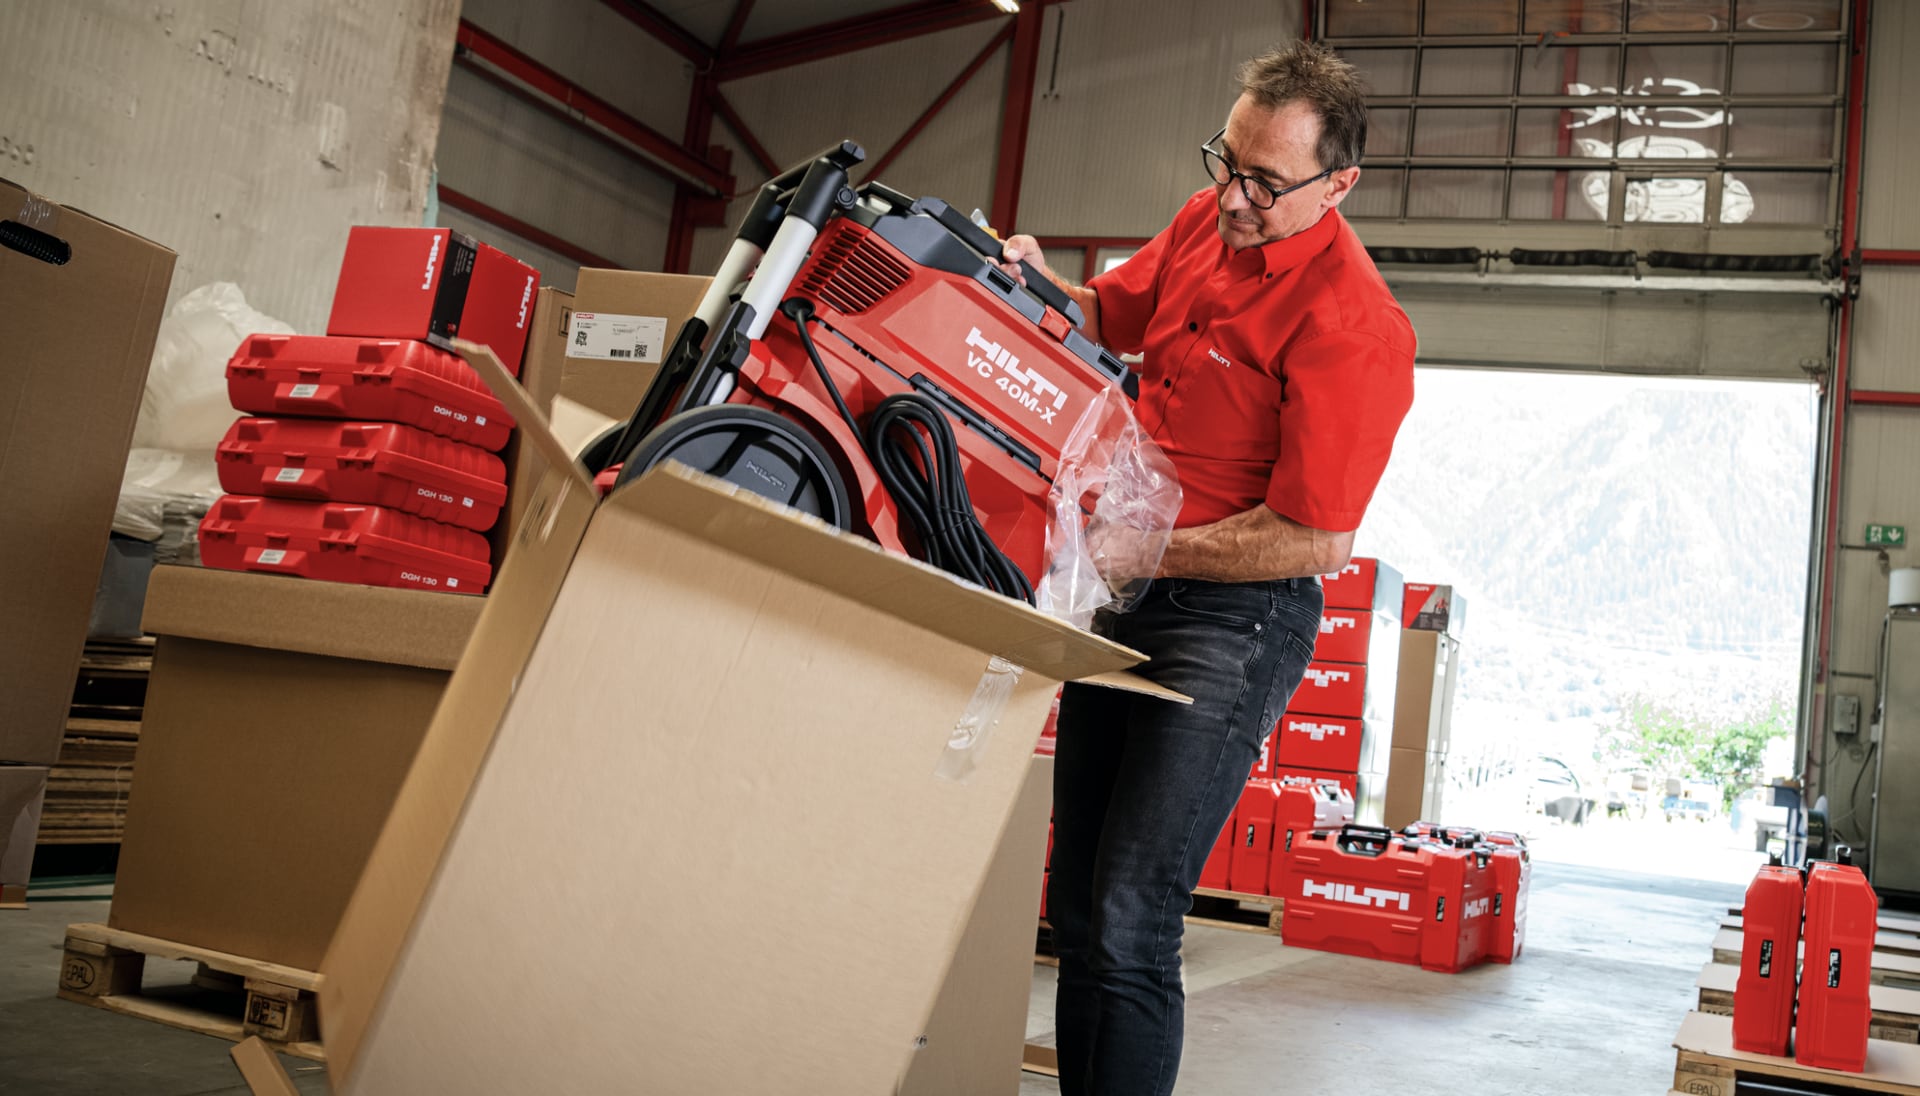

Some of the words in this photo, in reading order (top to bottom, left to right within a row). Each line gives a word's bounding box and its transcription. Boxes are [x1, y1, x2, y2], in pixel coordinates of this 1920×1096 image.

[422, 235, 442, 290] HILTI
[516, 275, 534, 328] HILTI
[965, 327, 1068, 410] HILTI
[1208, 348, 1231, 367] HILTI
[967, 350, 993, 378] VC
[995, 377, 1057, 425] 40M-X
[433, 405, 452, 417] DGH
[453, 411, 467, 422] 130
[418, 488, 436, 499] DGH
[438, 492, 453, 503] 130
[400, 571, 421, 582] DGH
[422, 577, 438, 586] 130
[1288, 721, 1346, 736] HILTI
[1303, 879, 1410, 911] HILTI
[1464, 897, 1490, 919] HILTI
